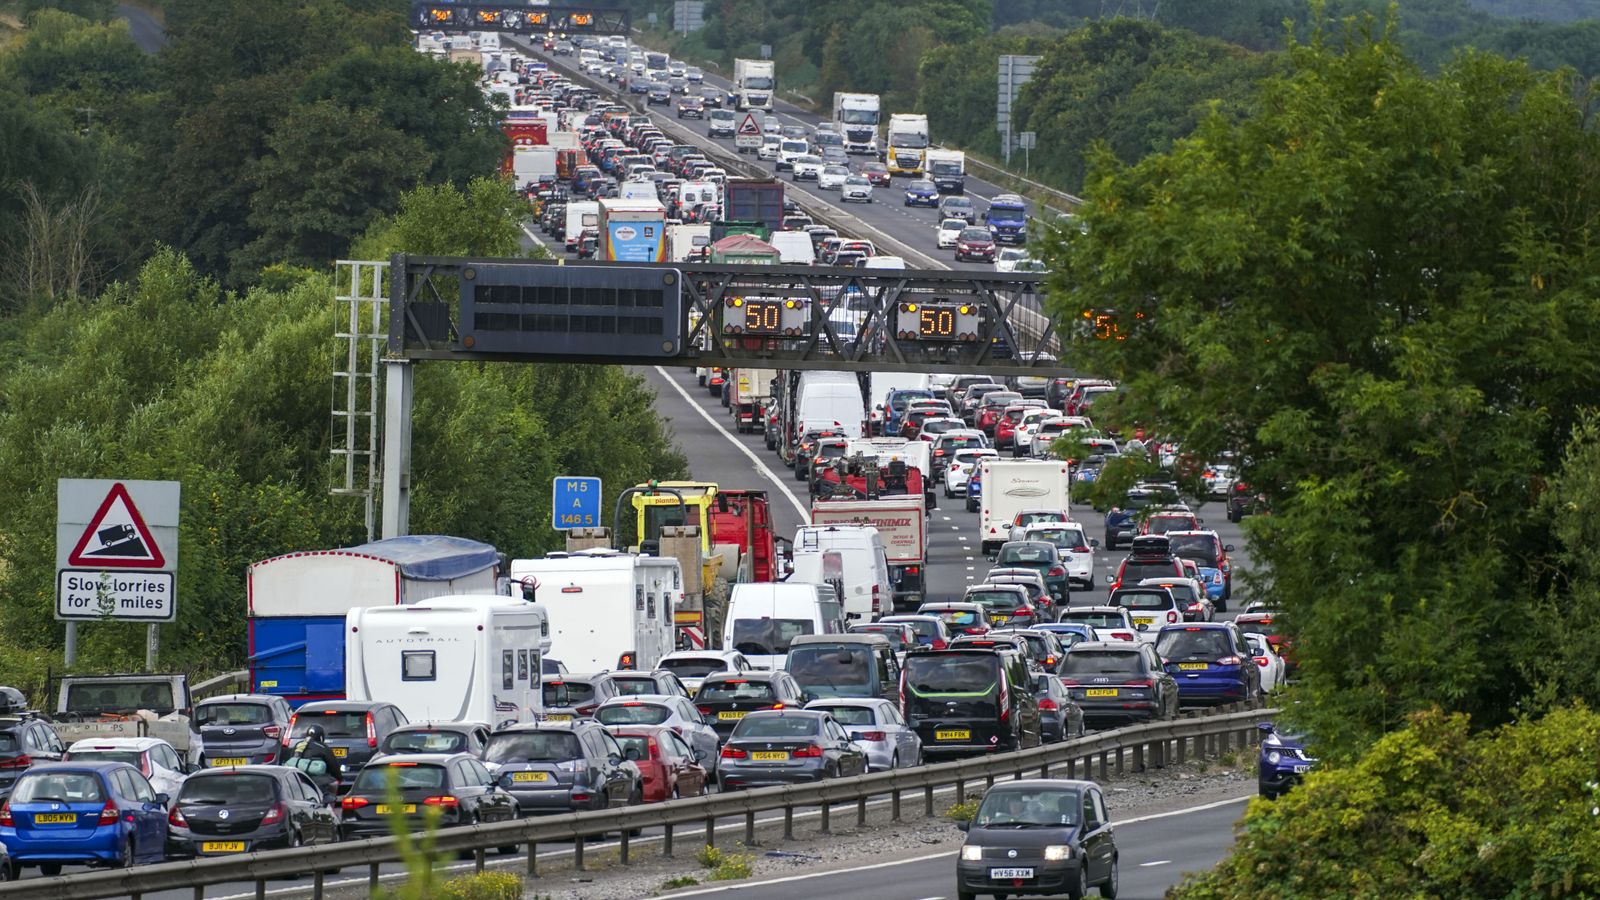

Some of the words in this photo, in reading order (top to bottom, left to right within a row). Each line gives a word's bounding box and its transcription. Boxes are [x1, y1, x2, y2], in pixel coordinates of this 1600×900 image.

[576, 16, 587, 25] 50
[746, 305, 778, 329] 50
[920, 310, 952, 335] 50
[567, 482, 588, 492] M5
[573, 498, 581, 508] A
[561, 514, 593, 524] 146.5
[67, 577, 107, 591] Slow
[113, 579, 165, 593] lorries
[67, 594, 91, 607] for
[121, 596, 163, 609] miles
